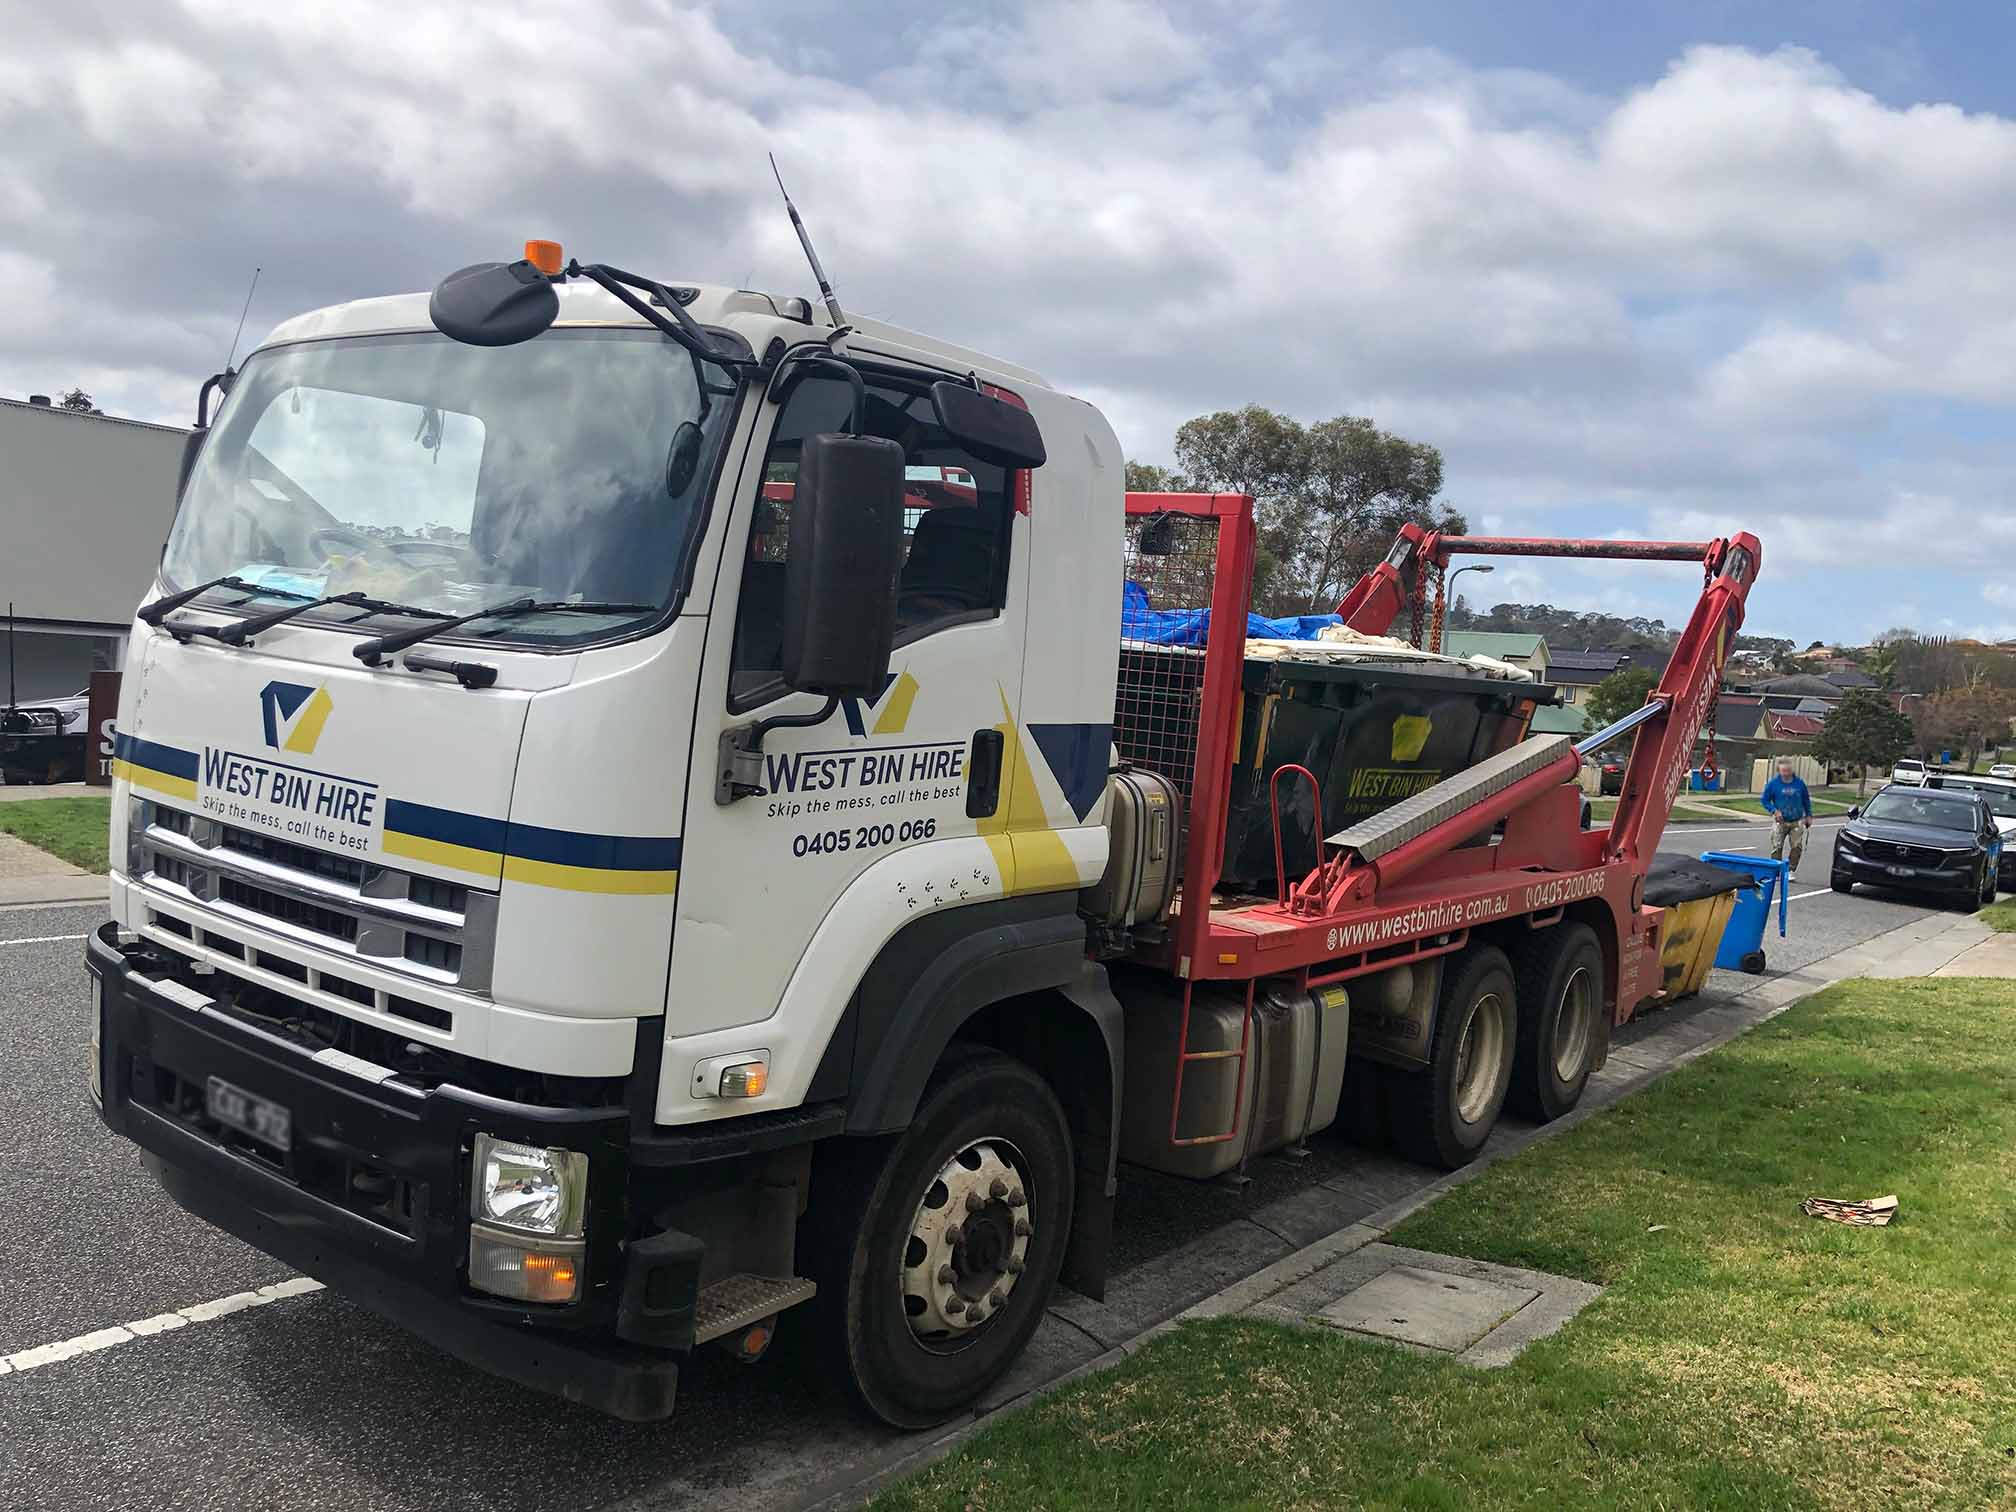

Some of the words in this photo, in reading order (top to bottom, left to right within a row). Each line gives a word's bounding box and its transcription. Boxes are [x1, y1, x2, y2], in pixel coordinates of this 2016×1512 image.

[205, 746, 269, 799] WEST
[270, 772, 312, 811] BIN
[315, 782, 377, 827] HIRE
[766, 752, 856, 794] WEST
[859, 754, 905, 786] BIN
[909, 749, 965, 781] HIRE
[1348, 767, 1391, 798] WEST
[1388, 775, 1414, 797] BIN
[767, 804, 800, 818] Skip
[807, 799, 830, 813] the
[835, 797, 875, 810] mess,
[880, 791, 905, 806] call
[909, 788, 929, 802] the
[934, 785, 961, 800] best
[202, 796, 225, 815] Skip
[229, 804, 247, 819] the
[250, 812, 283, 831] mess,
[287, 821, 311, 836] call
[315, 826, 335, 842] the
[339, 833, 369, 851] best
[793, 829, 851, 857] 0405
[855, 825, 895, 850] 200
[899, 818, 937, 842] 066
[1533, 880, 1563, 907] 0405
[1563, 875, 1584, 900] 200
[1585, 871, 1605, 894] 066
